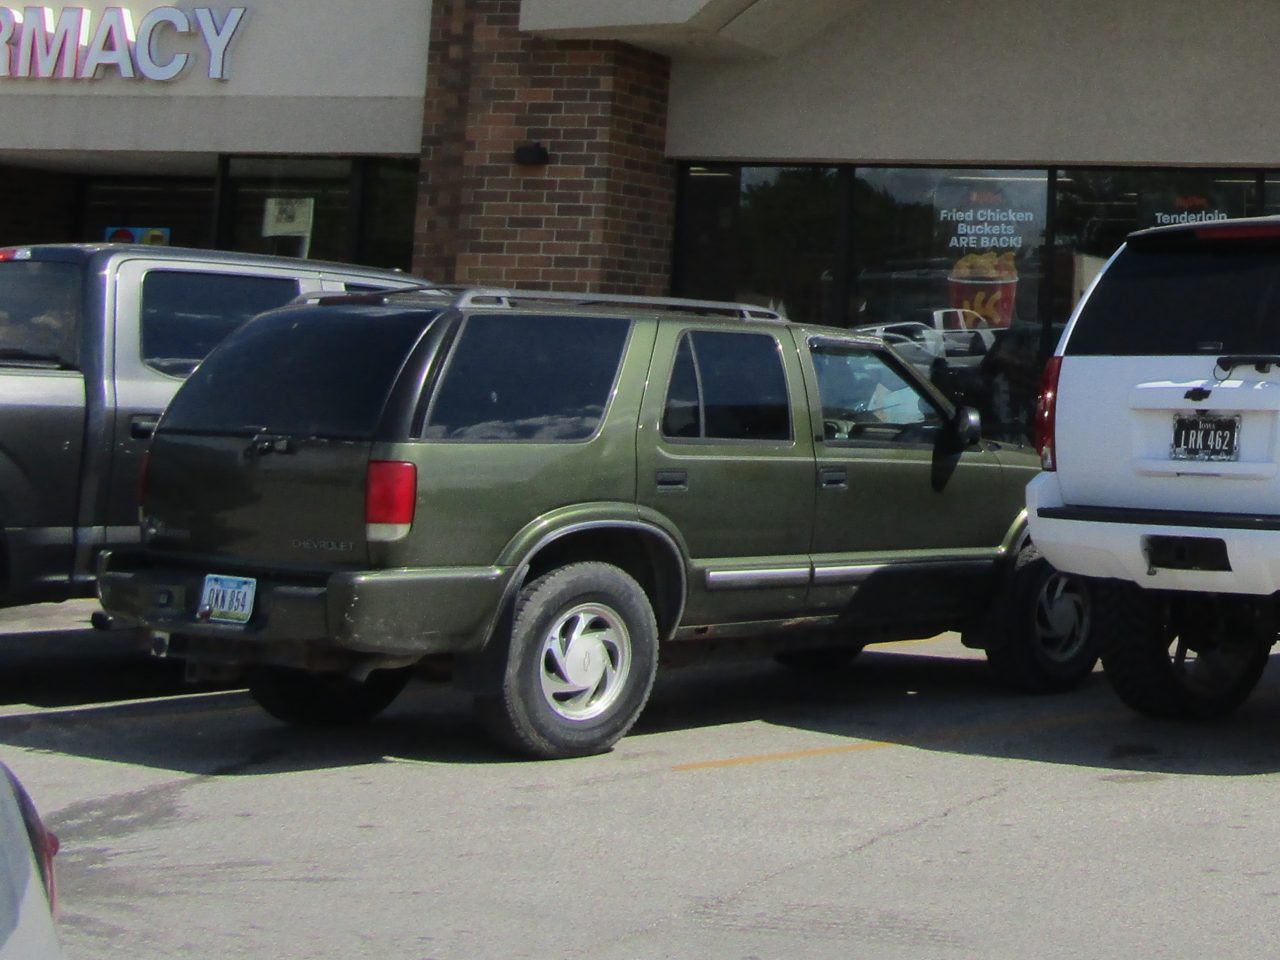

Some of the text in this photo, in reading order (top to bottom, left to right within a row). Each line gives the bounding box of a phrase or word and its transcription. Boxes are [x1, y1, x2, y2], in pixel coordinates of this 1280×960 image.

[940, 209, 1033, 221] Fried Chicken
[1155, 210, 1227, 224] Tenderloin
[957, 223, 1015, 234] Buckets
[949, 236, 1022, 247] ARE BACK!
[1181, 430, 1230, 450] LRK 462
